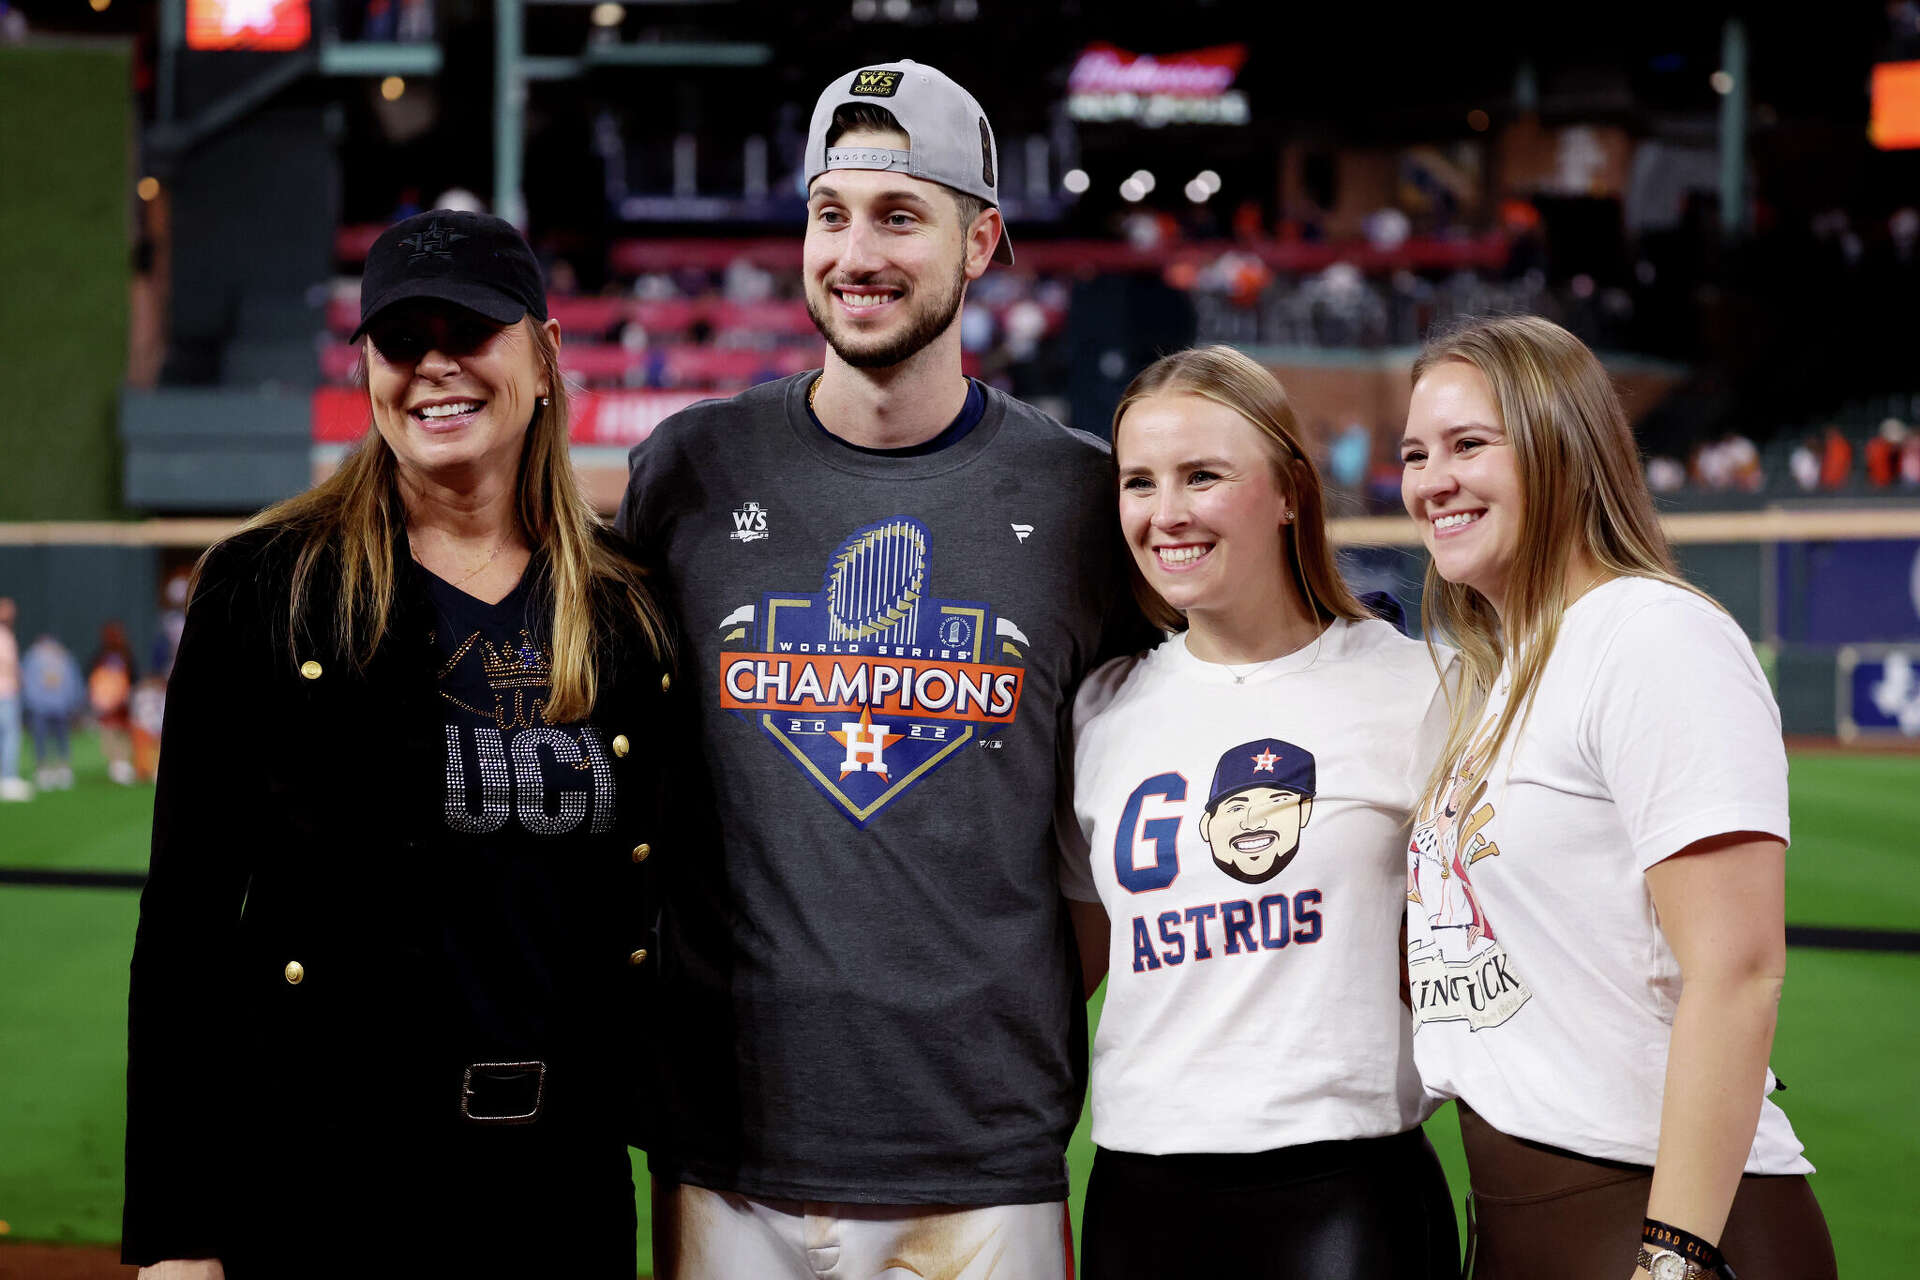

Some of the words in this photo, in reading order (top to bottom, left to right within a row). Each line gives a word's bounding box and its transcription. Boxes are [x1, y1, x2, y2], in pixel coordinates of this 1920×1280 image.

[855, 85, 891, 94] CHAMPS
[860, 74, 895, 87] WS
[732, 511, 767, 531] WS
[779, 641, 859, 653] WORLD
[878, 645, 968, 660] SERIES
[724, 659, 1019, 717] CHAMPIONS
[840, 722, 891, 773] H
[1253, 754, 1277, 771] H
[1113, 770, 1189, 895] G
[1131, 887, 1324, 974] ASTROS
